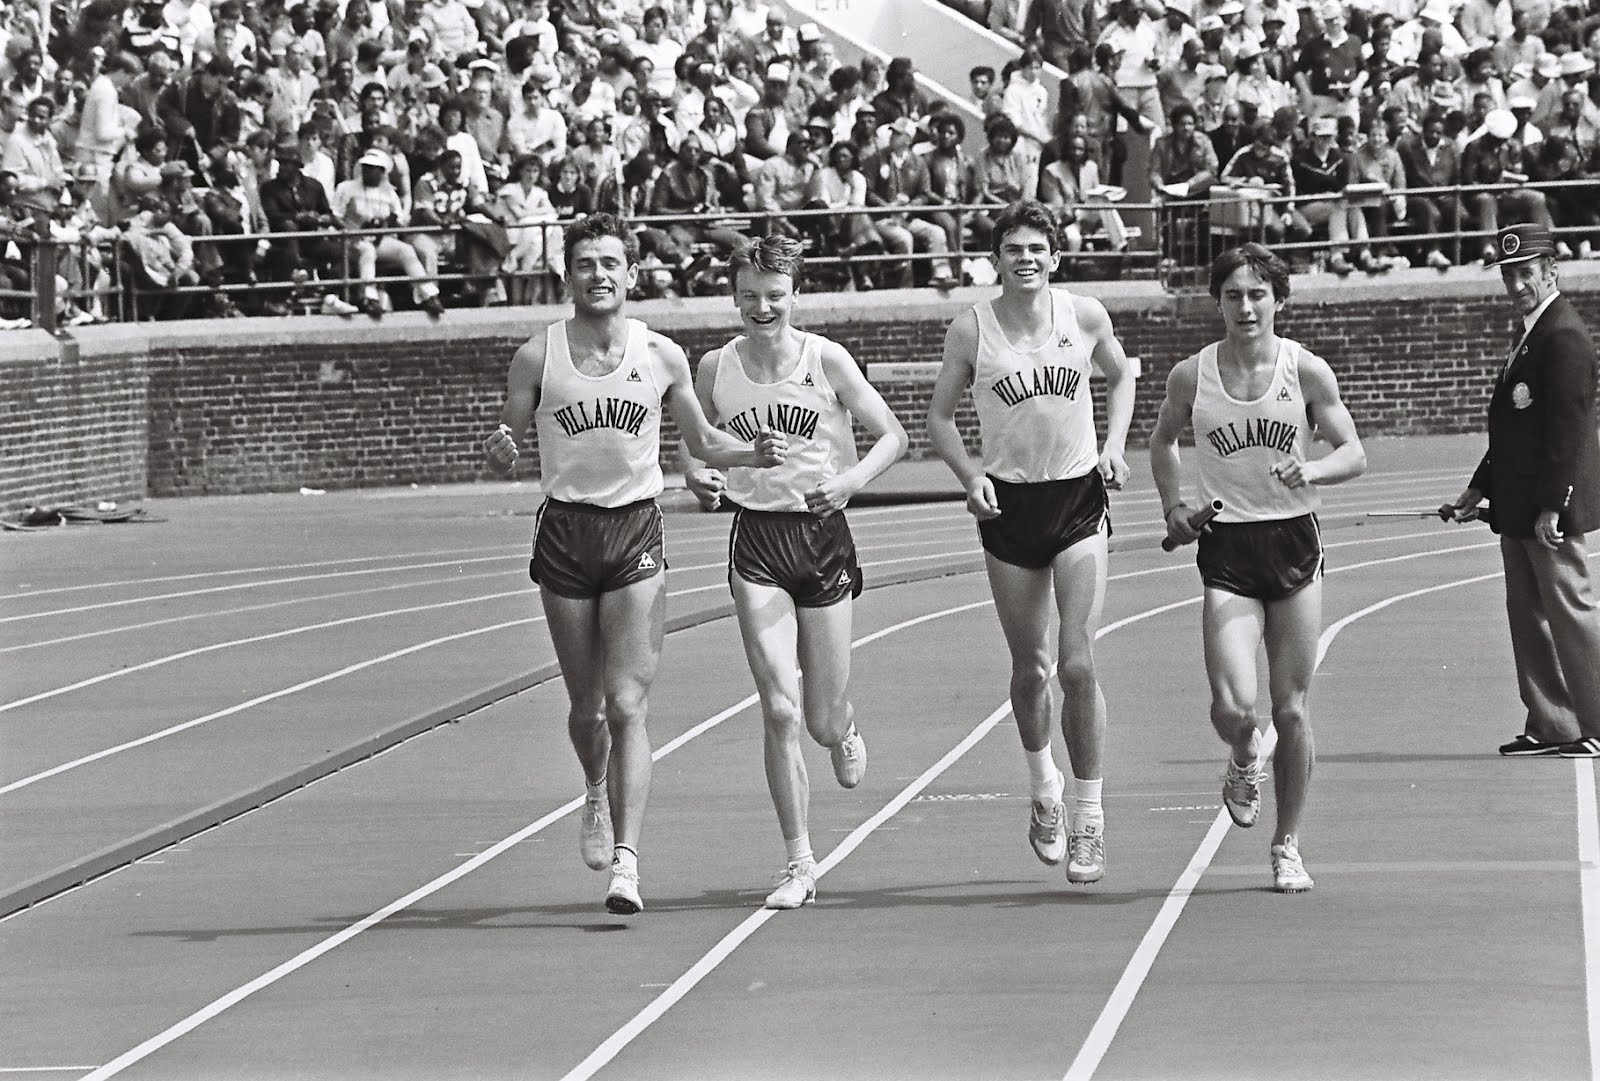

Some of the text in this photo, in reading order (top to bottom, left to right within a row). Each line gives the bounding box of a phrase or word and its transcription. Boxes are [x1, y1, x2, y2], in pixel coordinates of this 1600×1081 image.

[991, 365, 1081, 407] VILLANOVA
[553, 397, 648, 437] VILLANOVA
[728, 403, 819, 443] VILLANOVA
[1206, 418, 1298, 457] VILLANOVA
